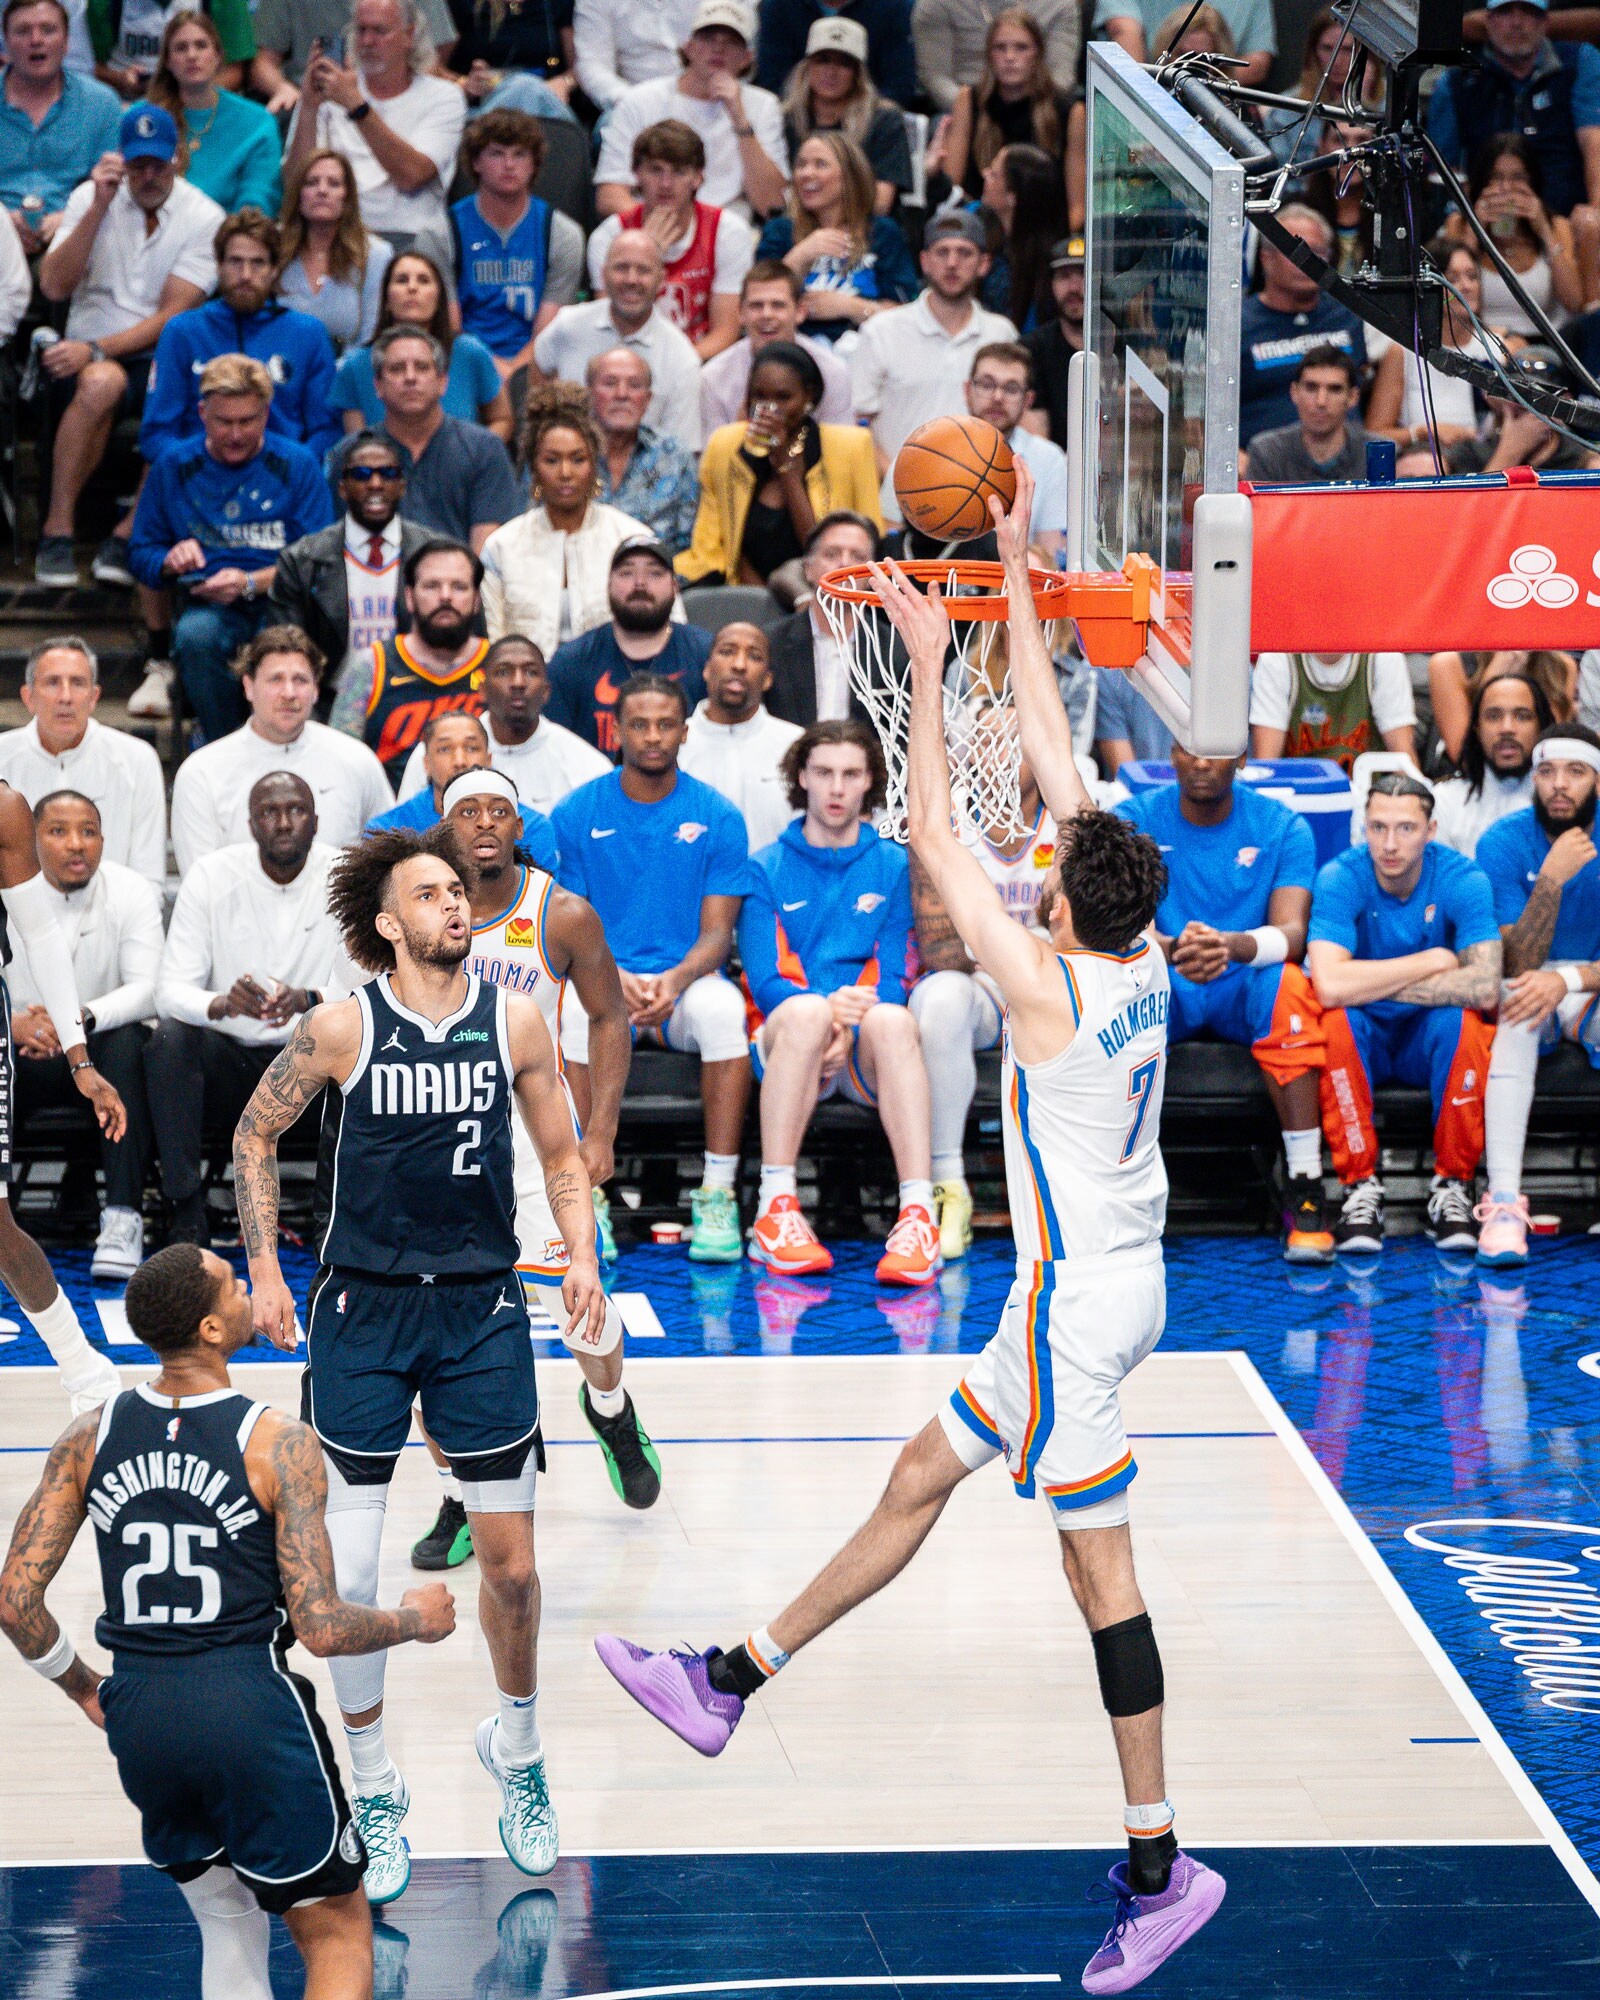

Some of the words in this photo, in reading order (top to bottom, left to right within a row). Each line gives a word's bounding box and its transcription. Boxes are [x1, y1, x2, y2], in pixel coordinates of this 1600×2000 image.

[452, 1029, 489, 1042] chime
[371, 1061, 497, 1115] MAVS
[1119, 1052, 1160, 1165] 7
[451, 1119, 482, 1176] 2
[215, 1494, 260, 1541] JR.
[121, 1521, 223, 1625] 25
